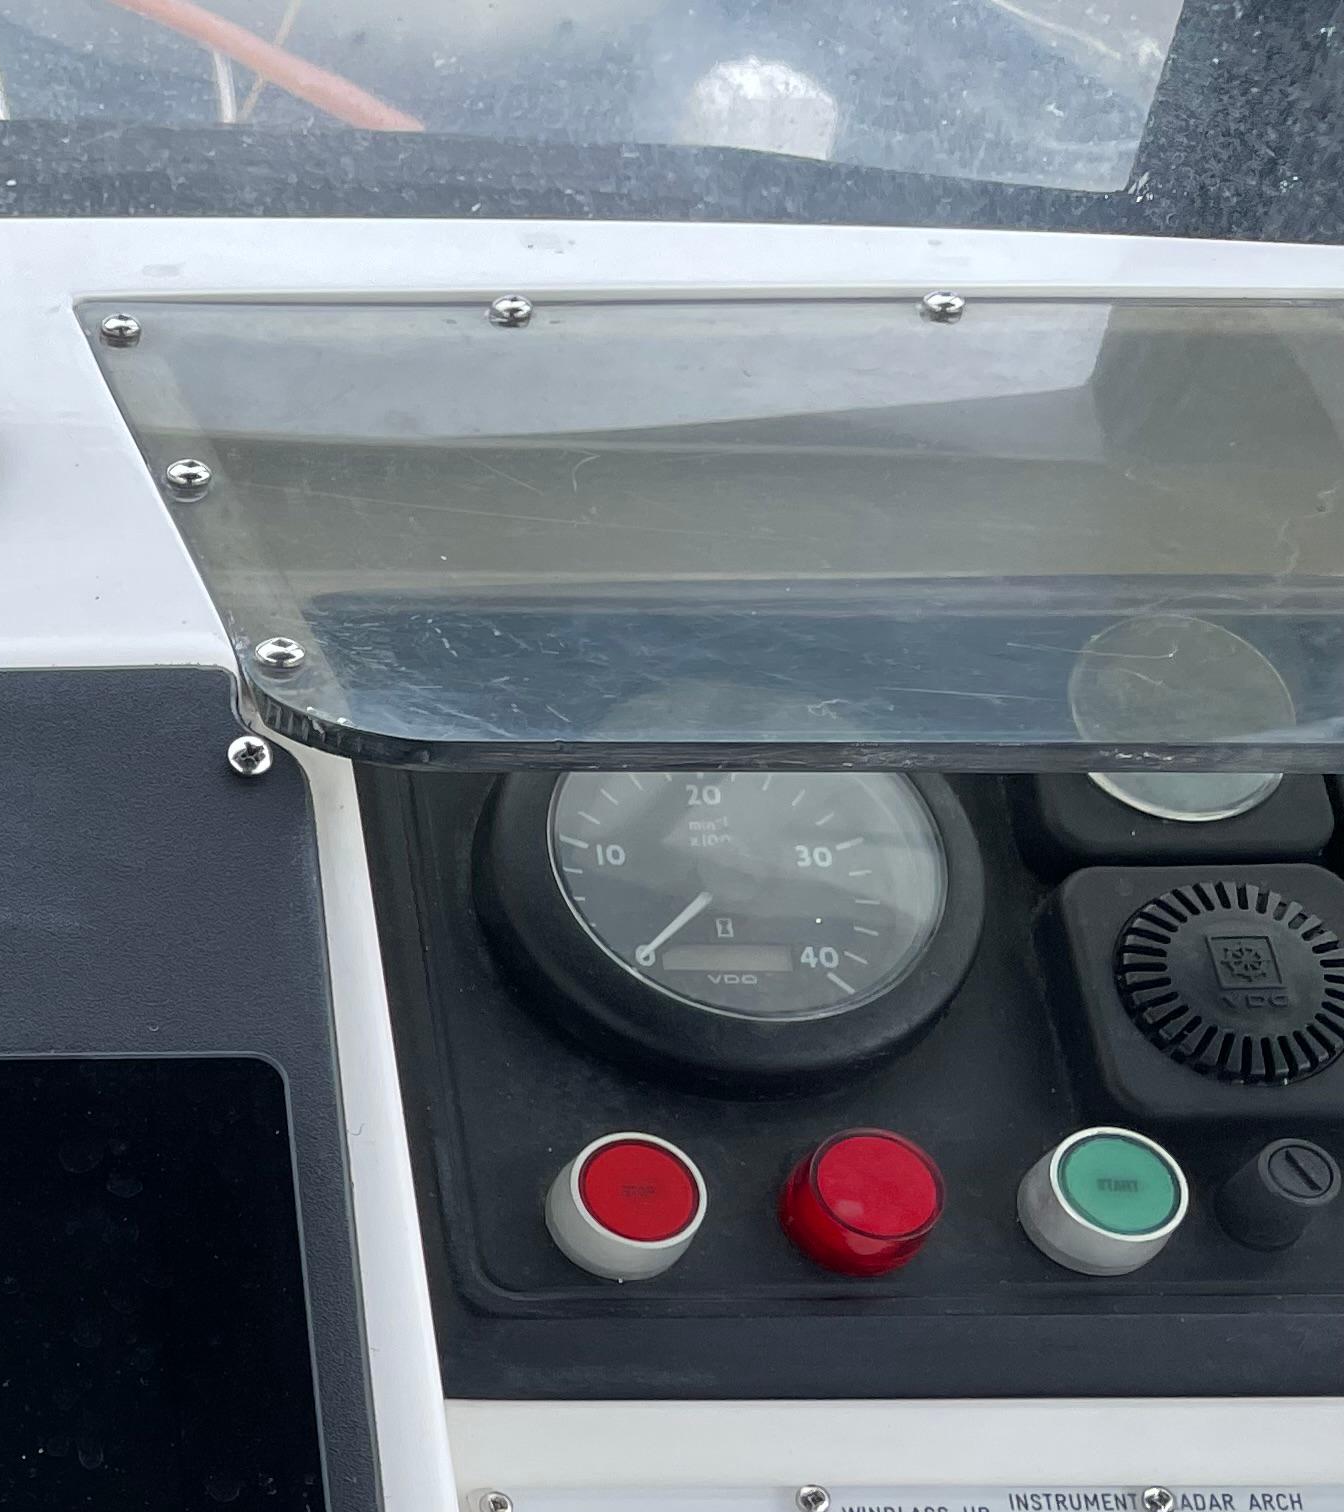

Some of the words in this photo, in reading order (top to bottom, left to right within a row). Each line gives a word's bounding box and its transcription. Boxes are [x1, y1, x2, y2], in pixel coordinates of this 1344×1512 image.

[686, 784, 722, 805] 20
[596, 844, 627, 866] 10
[795, 845, 833, 867] 30
[634, 944, 656, 966] 0
[800, 946, 839, 968] 40
[707, 973, 758, 985] VDO
[1008, 1492, 1139, 1512] INSTRUMENT
[1175, 1493, 1236, 1511] ADAR
[1248, 1493, 1303, 1511] ARCH
